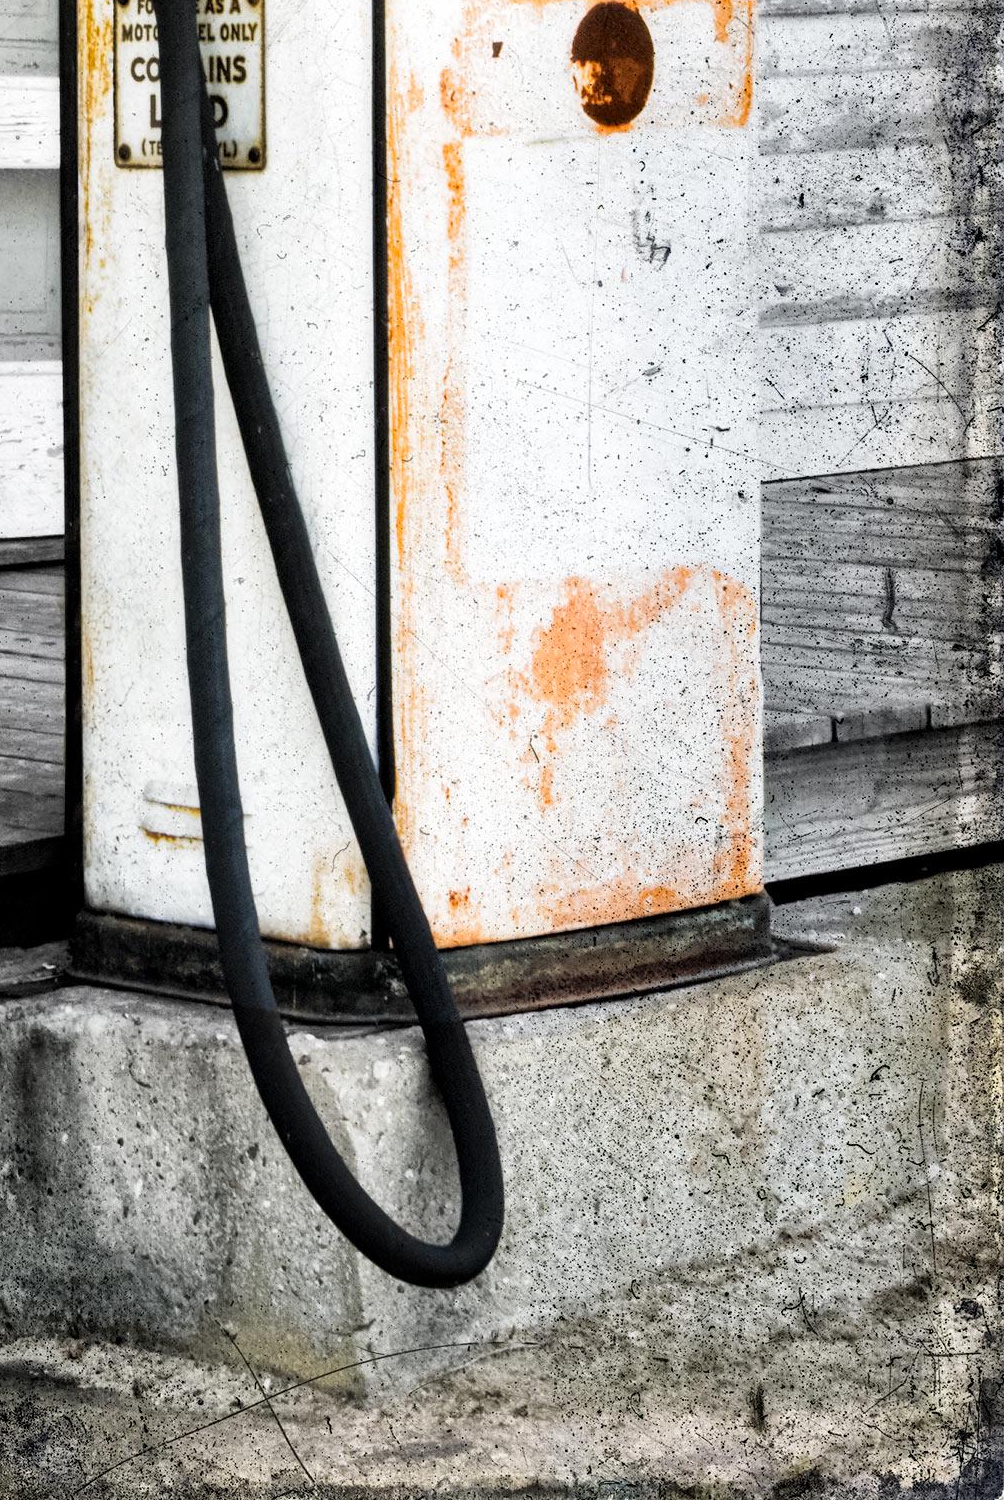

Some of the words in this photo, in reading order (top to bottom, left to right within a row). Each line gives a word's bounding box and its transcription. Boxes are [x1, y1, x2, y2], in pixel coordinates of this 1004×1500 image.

[122, 24, 159, 42] MOTO
[220, 23, 258, 42] ONLY
[131, 55, 246, 84] COINS
[150, 94, 229, 129] LD
